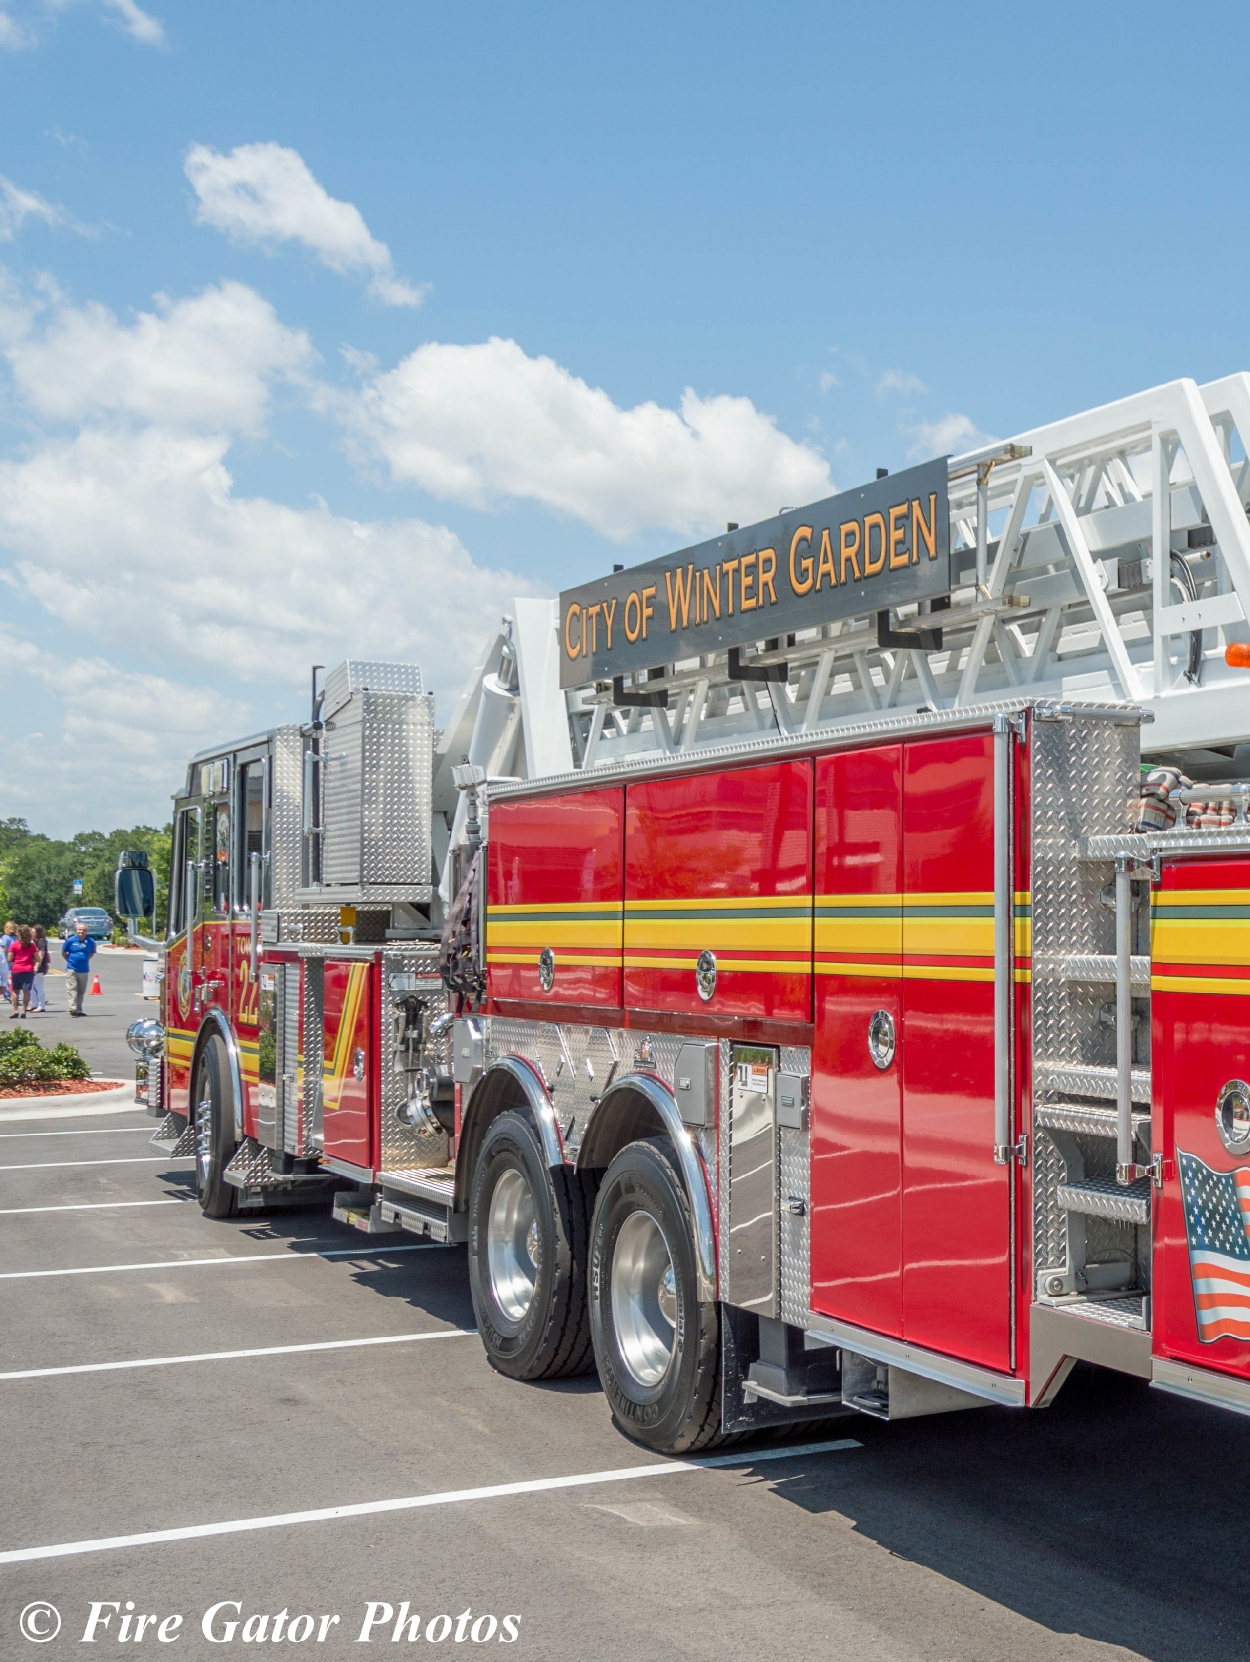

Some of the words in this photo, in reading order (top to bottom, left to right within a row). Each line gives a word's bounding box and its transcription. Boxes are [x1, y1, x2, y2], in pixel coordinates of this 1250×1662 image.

[565, 597, 618, 661] CITY
[624, 583, 657, 644] OF
[664, 546, 779, 633] WINTER
[788, 491, 939, 598] GARDEN
[238, 958, 258, 1026] 22
